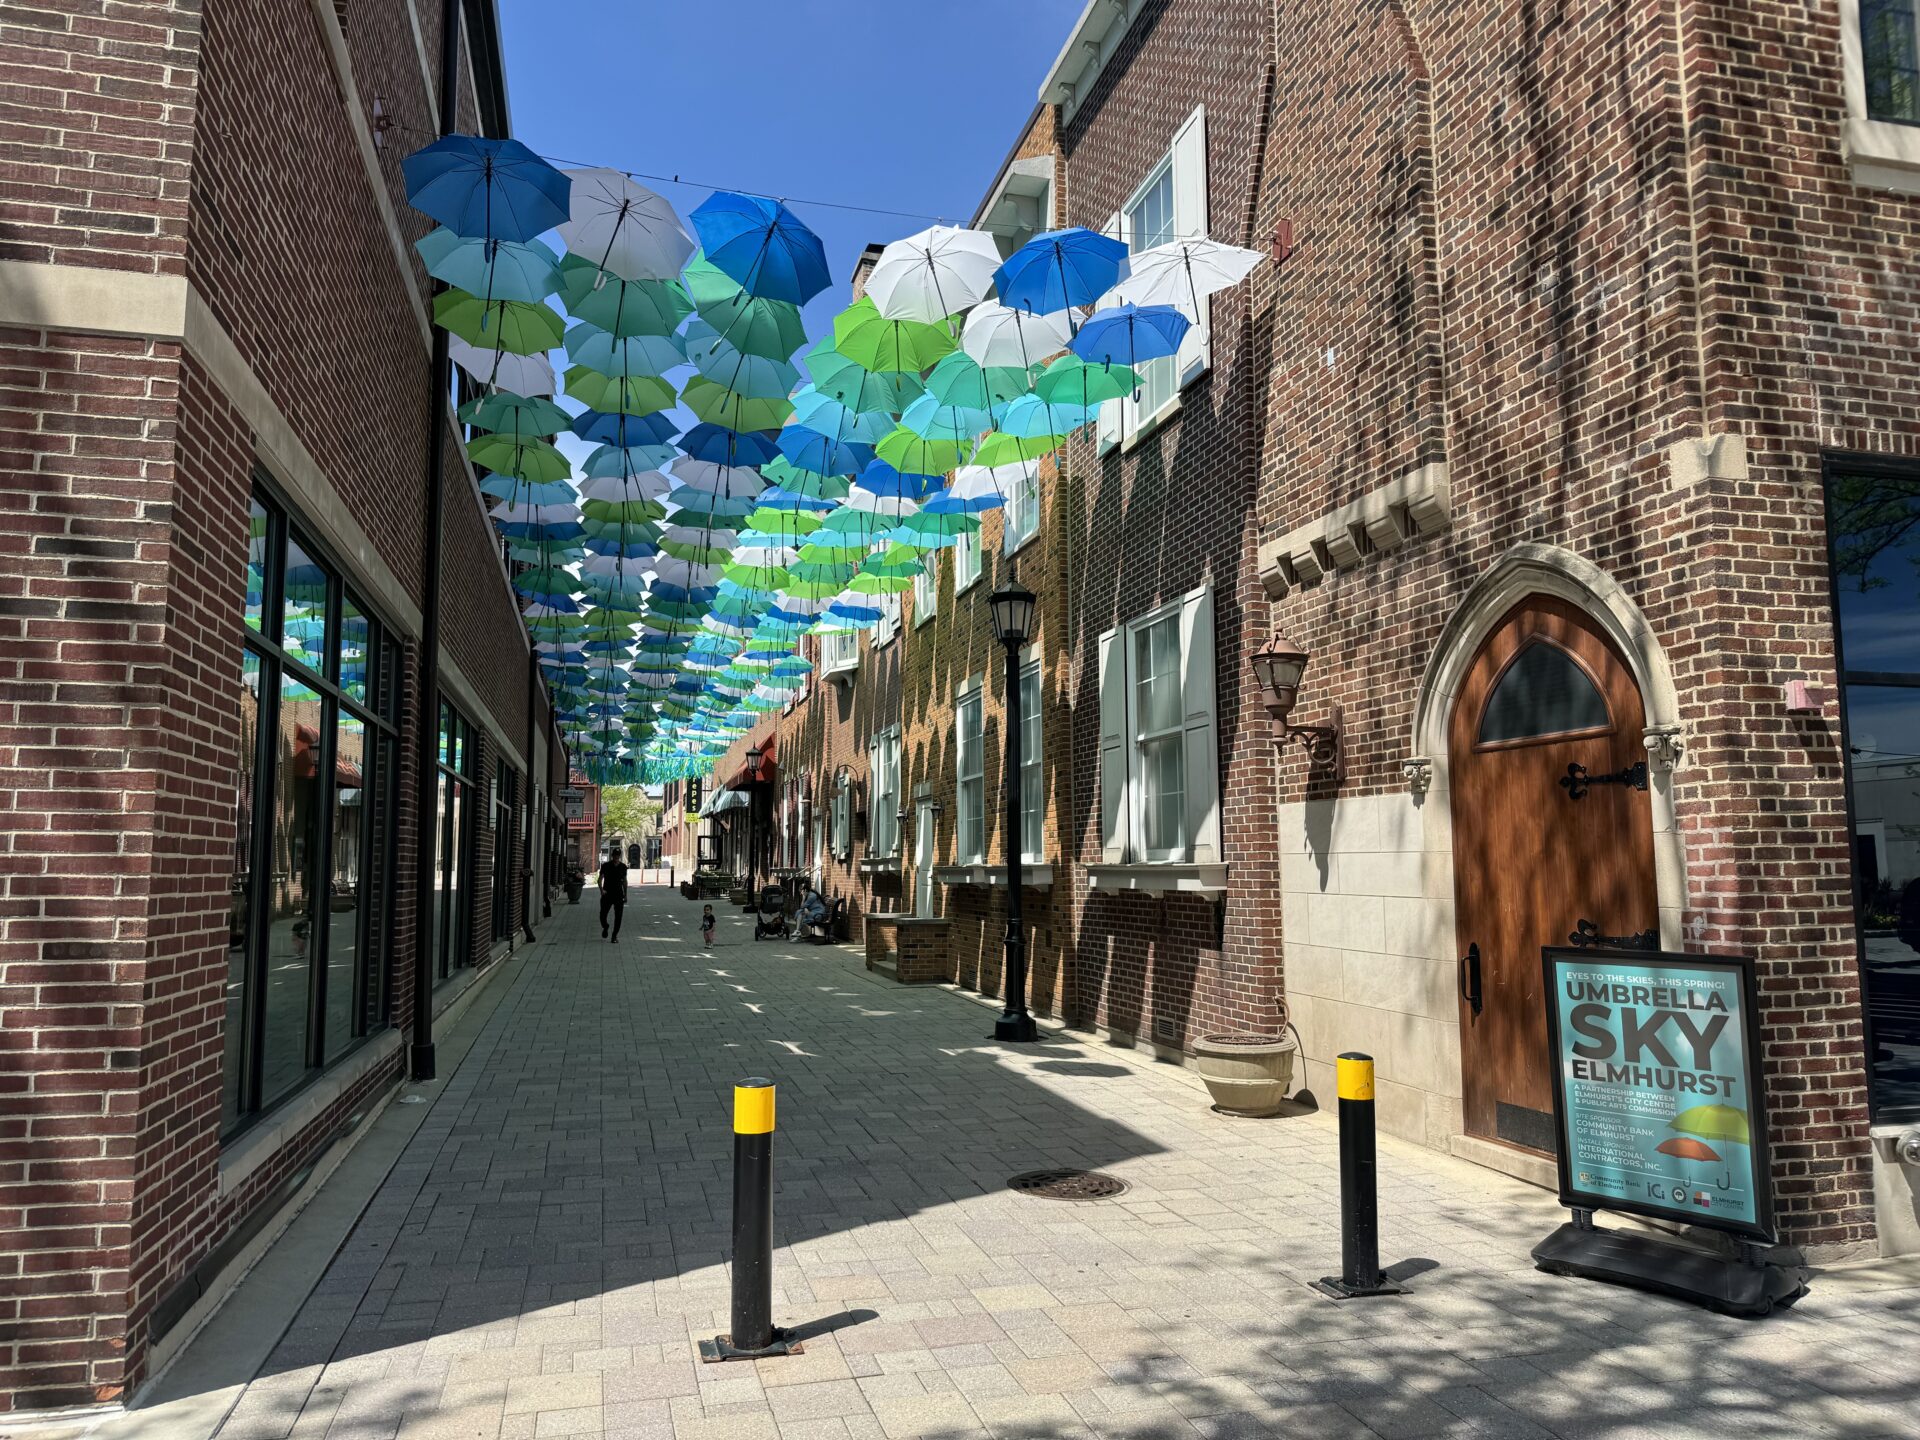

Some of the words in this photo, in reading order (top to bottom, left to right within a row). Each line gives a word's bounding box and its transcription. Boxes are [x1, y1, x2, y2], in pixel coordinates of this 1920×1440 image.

[1567, 972, 1589, 980] EYES
[1627, 976, 1657, 985] SKIES,
[1659, 978, 1682, 986] THIS
[1684, 980, 1725, 989] SPRING!
[1567, 982, 1728, 1012] UMBRELLA
[1570, 1003, 1729, 1071] SKY
[1572, 1060, 1736, 1097] ELMHURST
[1575, 1091, 1622, 1102] ELMHURST'S
[1644, 1100, 1675, 1109] CENTRE
[1581, 1086, 1634, 1096] PARTNERSHIP
[1636, 1092, 1674, 1101] BETWEEN
[1629, 1105, 1677, 1116] COMMISSION
[1576, 1120, 1626, 1132] COMMUNITY
[1630, 1126, 1654, 1136] BANK
[1590, 1129, 1635, 1141] ELMHURST
[1578, 1138, 1601, 1146] INSTALL
[1578, 1144, 1645, 1160] INTERNATIONAL
[1579, 1152, 1643, 1168] CONTRACTORS,
[1645, 1163, 1662, 1171] INC.
[1591, 1174, 1624, 1184] Community
[1626, 1179, 1641, 1187] Bank
[1598, 1182, 1624, 1190] Elmhurst
[1712, 1197, 1744, 1206] ELMHURST
